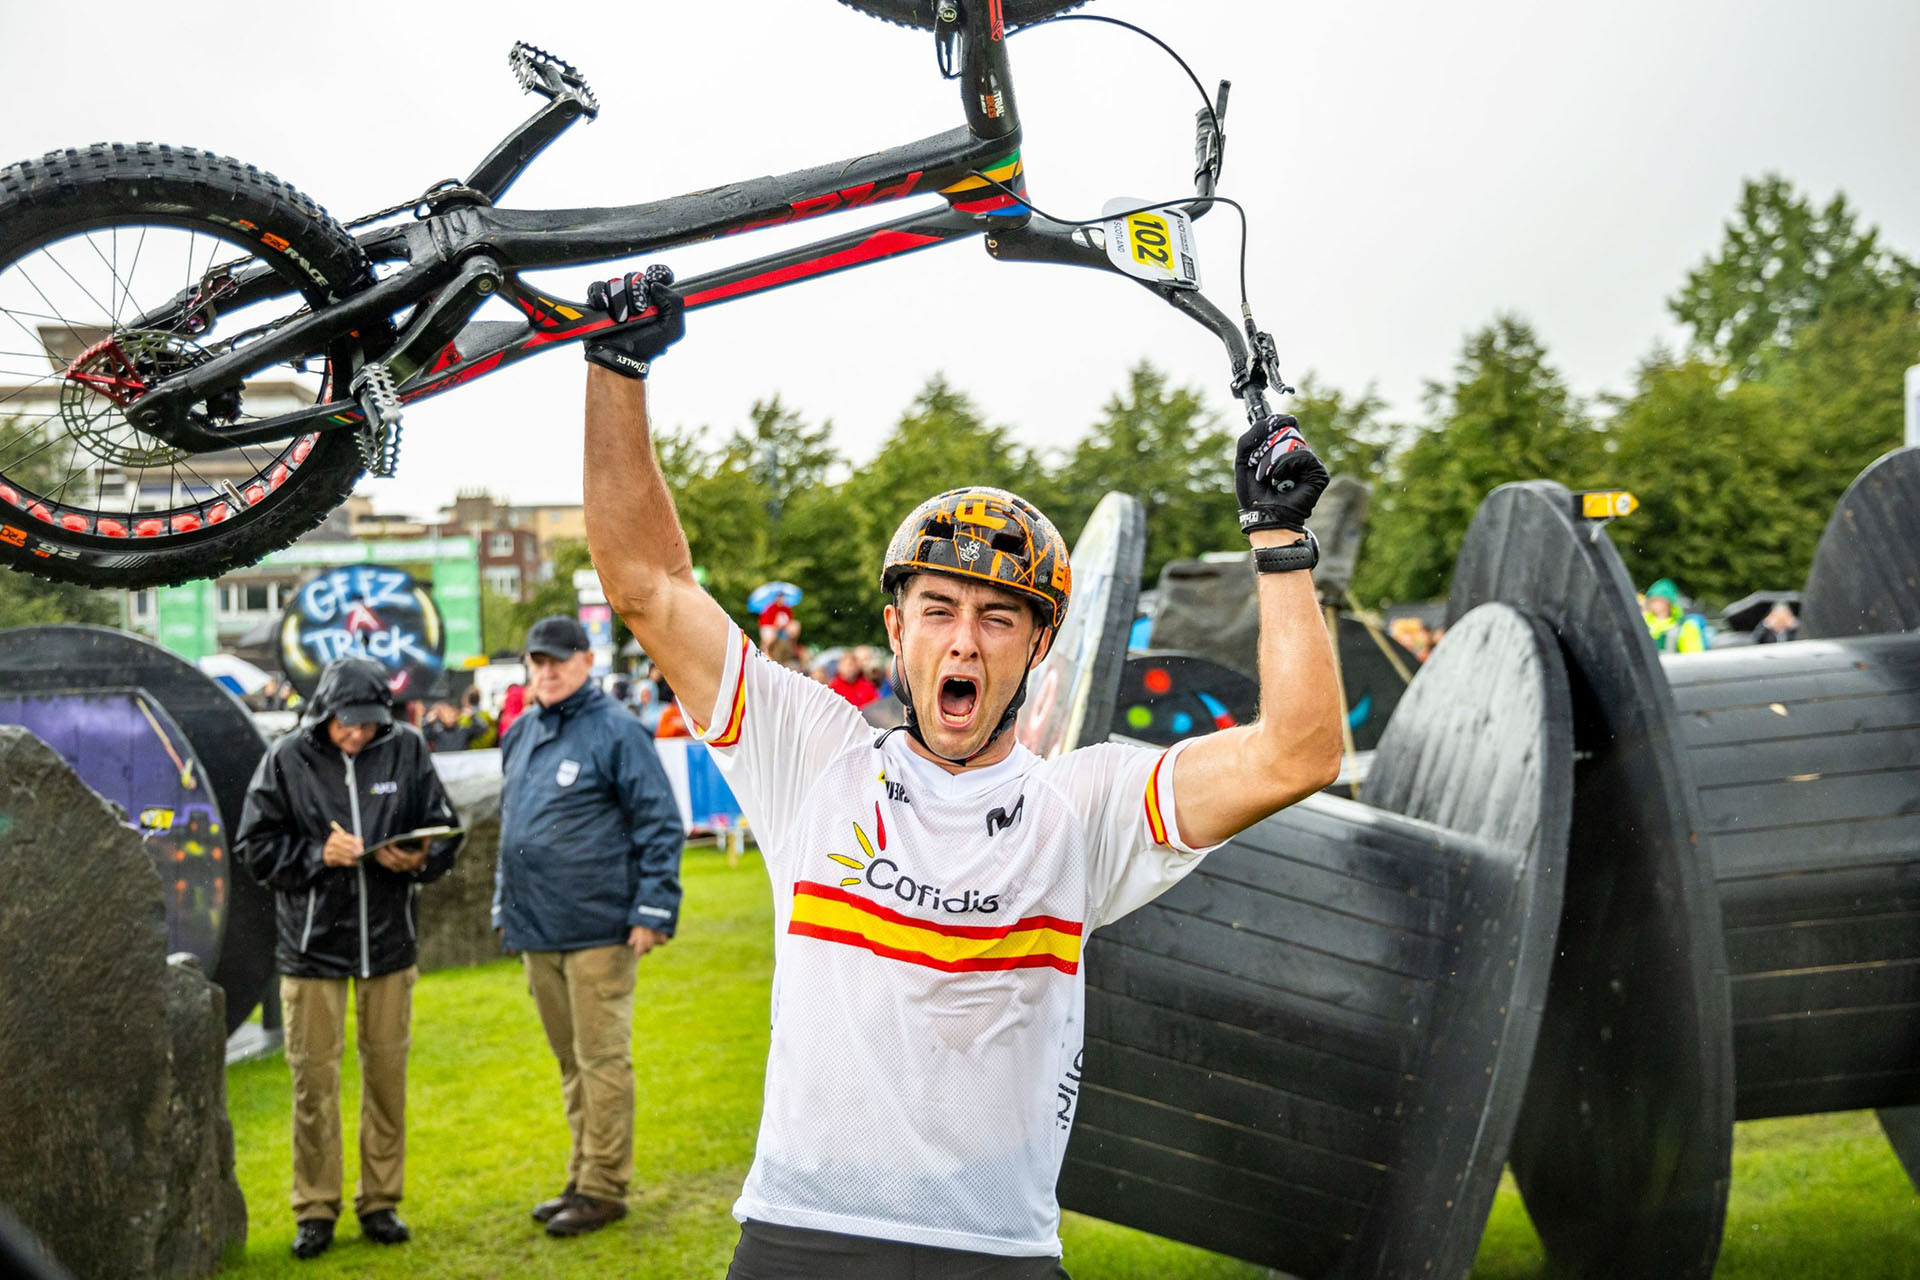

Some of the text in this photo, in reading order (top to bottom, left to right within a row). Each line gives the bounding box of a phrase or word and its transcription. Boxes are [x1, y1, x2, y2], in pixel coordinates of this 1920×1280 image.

[1113, 221, 1125, 253] SCOTLAND
[1133, 219, 1169, 264] 102
[304, 569, 414, 622] GEEZ
[349, 602, 380, 632] A
[865, 858, 1000, 913] Cofidis
